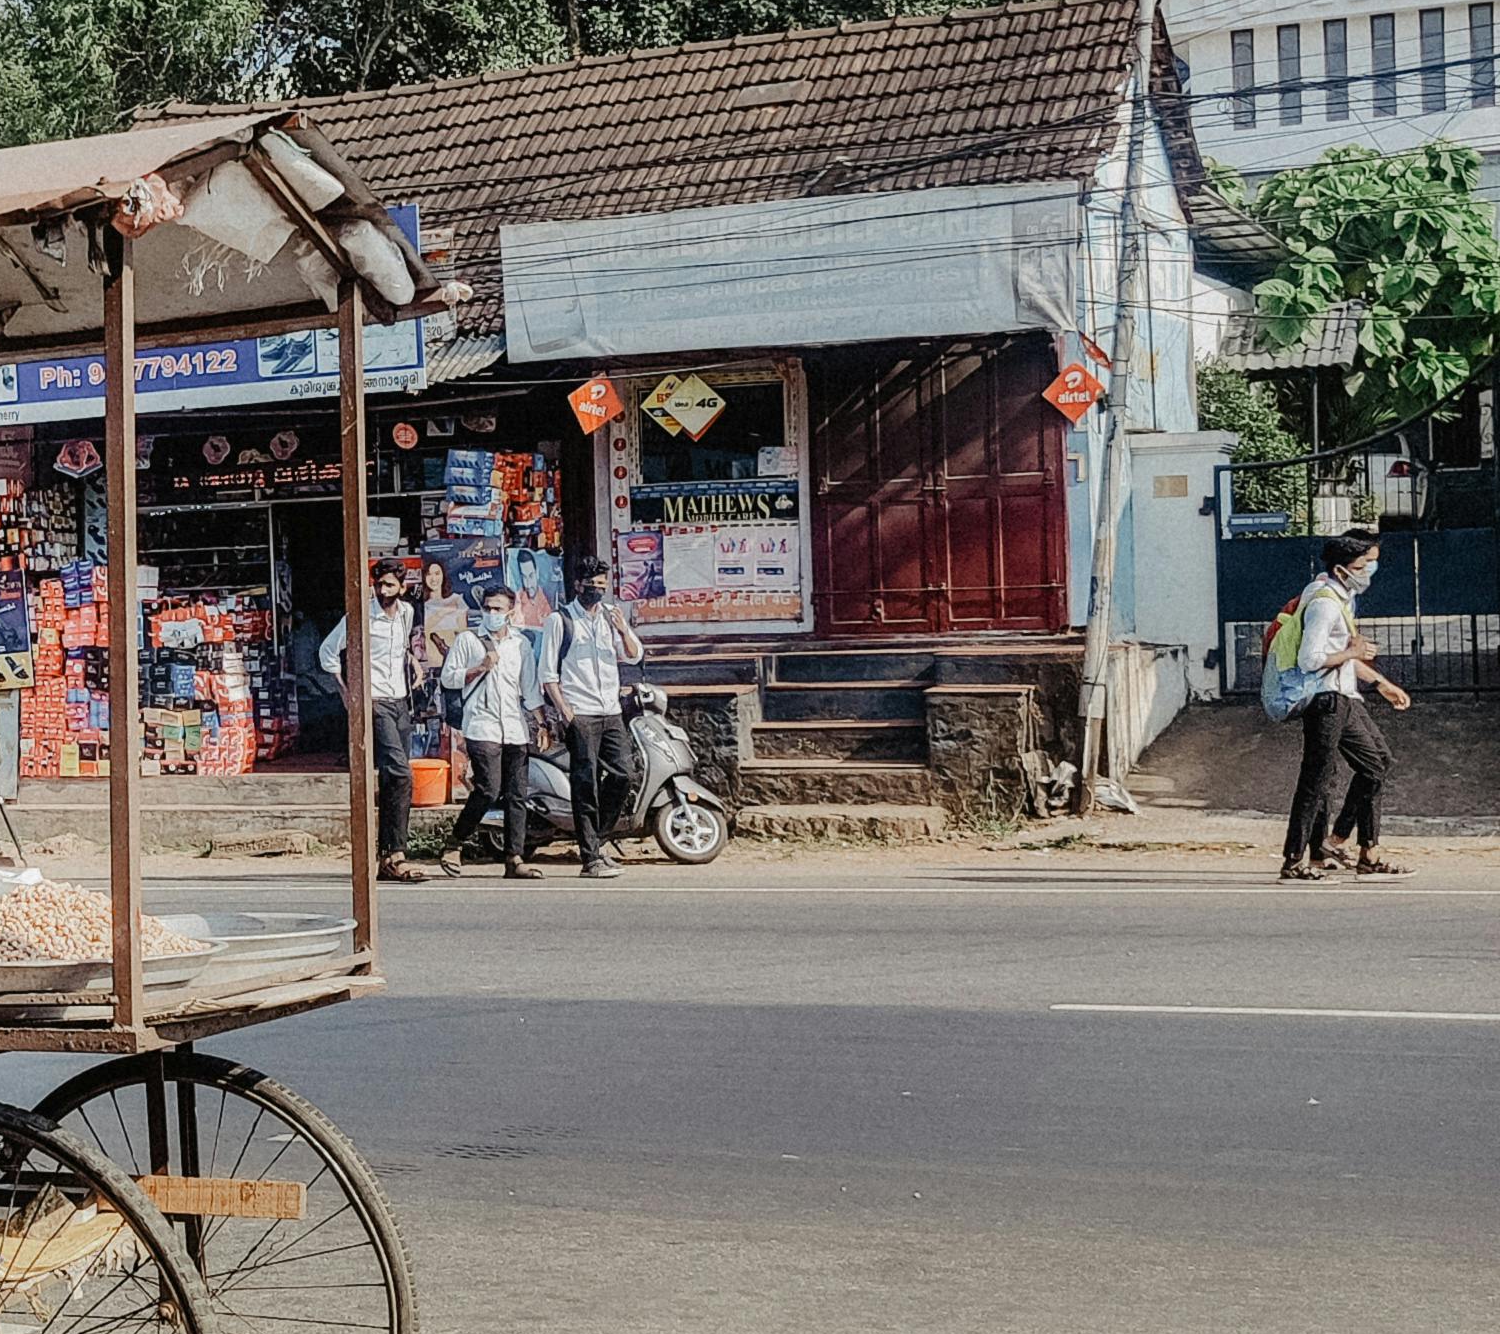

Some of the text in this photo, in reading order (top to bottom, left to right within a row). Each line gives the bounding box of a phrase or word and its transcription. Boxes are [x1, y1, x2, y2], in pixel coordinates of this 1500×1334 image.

[811, 264, 961, 290] Accessories
[39, 349, 237, 390] Ph: 97794122
[695, 397, 718, 409] 4G
[1058, 390, 1091, 404] airtel
[578, 401, 606, 418] airtel
[663, 493, 771, 523] MATHEWS
